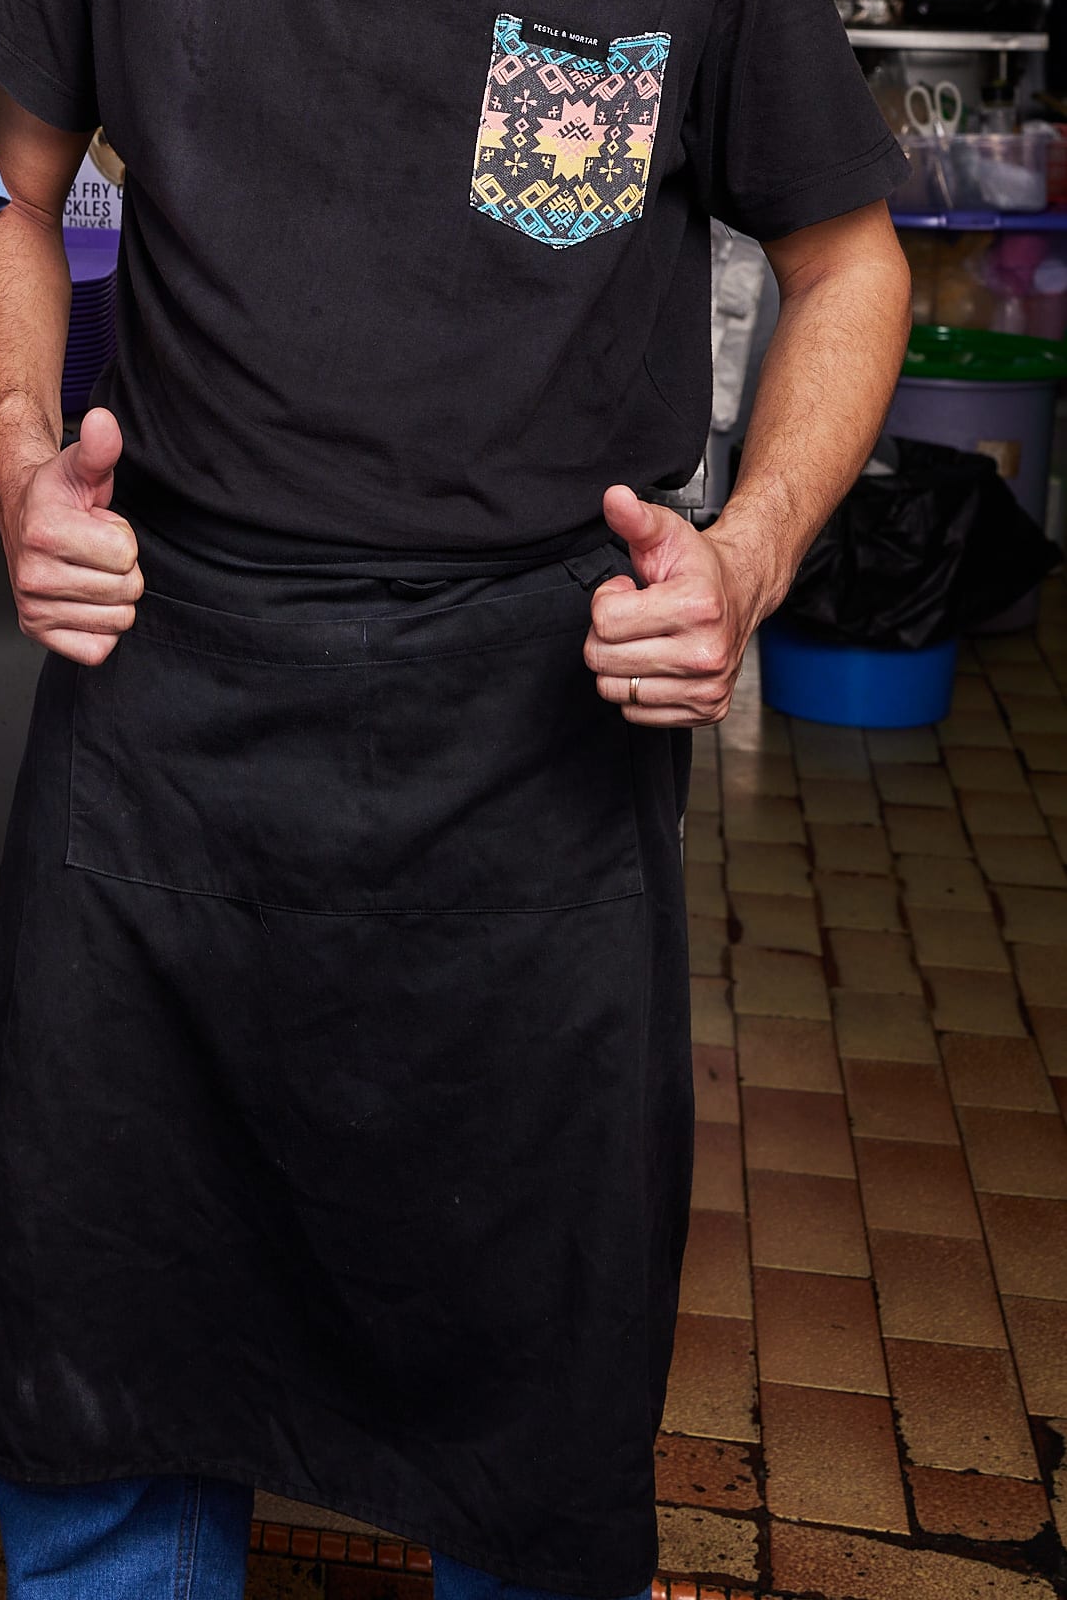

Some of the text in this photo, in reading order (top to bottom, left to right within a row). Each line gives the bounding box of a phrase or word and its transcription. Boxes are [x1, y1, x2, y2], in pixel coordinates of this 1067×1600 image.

[533, 23, 559, 37] PESTLE
[569, 32, 599, 46] MORTAR
[82, 182, 111, 198] FRY
